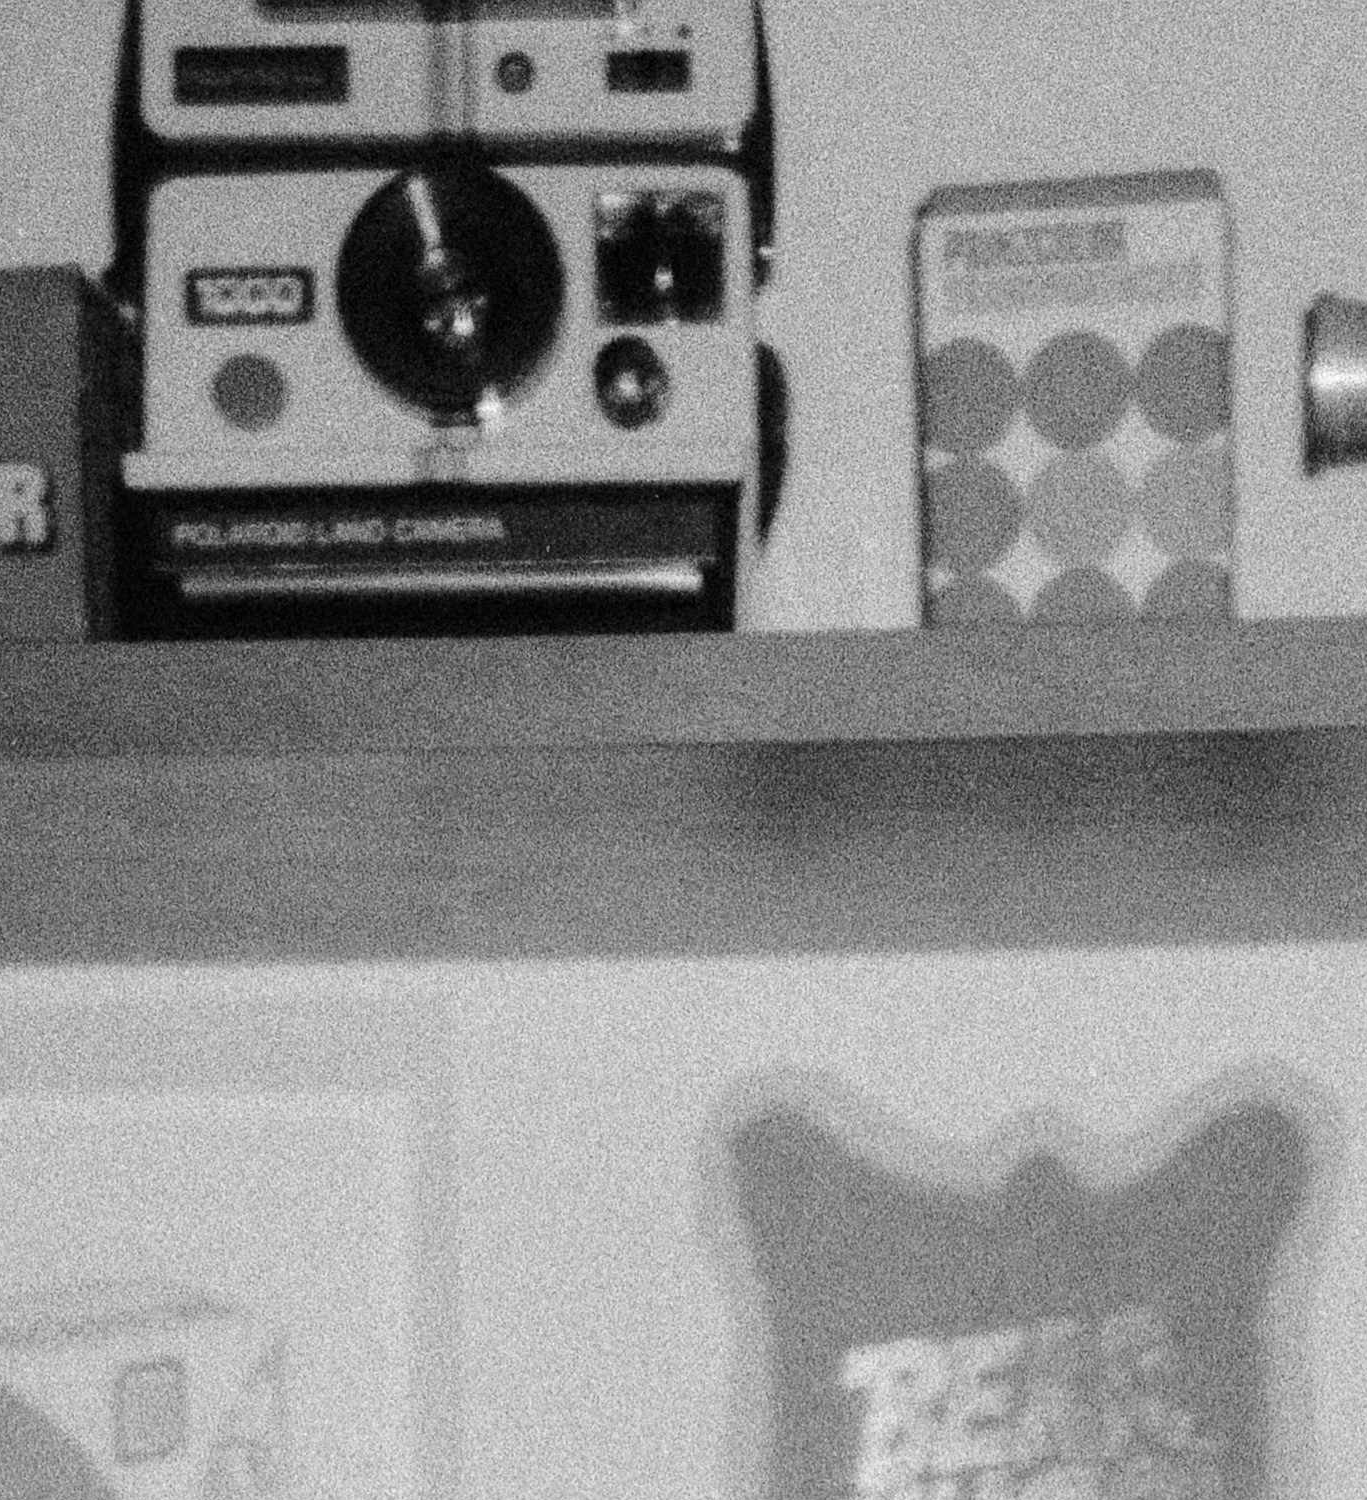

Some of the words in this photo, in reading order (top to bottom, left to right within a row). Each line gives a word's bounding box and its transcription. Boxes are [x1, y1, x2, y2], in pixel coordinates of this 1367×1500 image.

[171, 519, 308, 548] POLAROID
[314, 517, 386, 546] LAND
[392, 512, 506, 544] CAMERA
